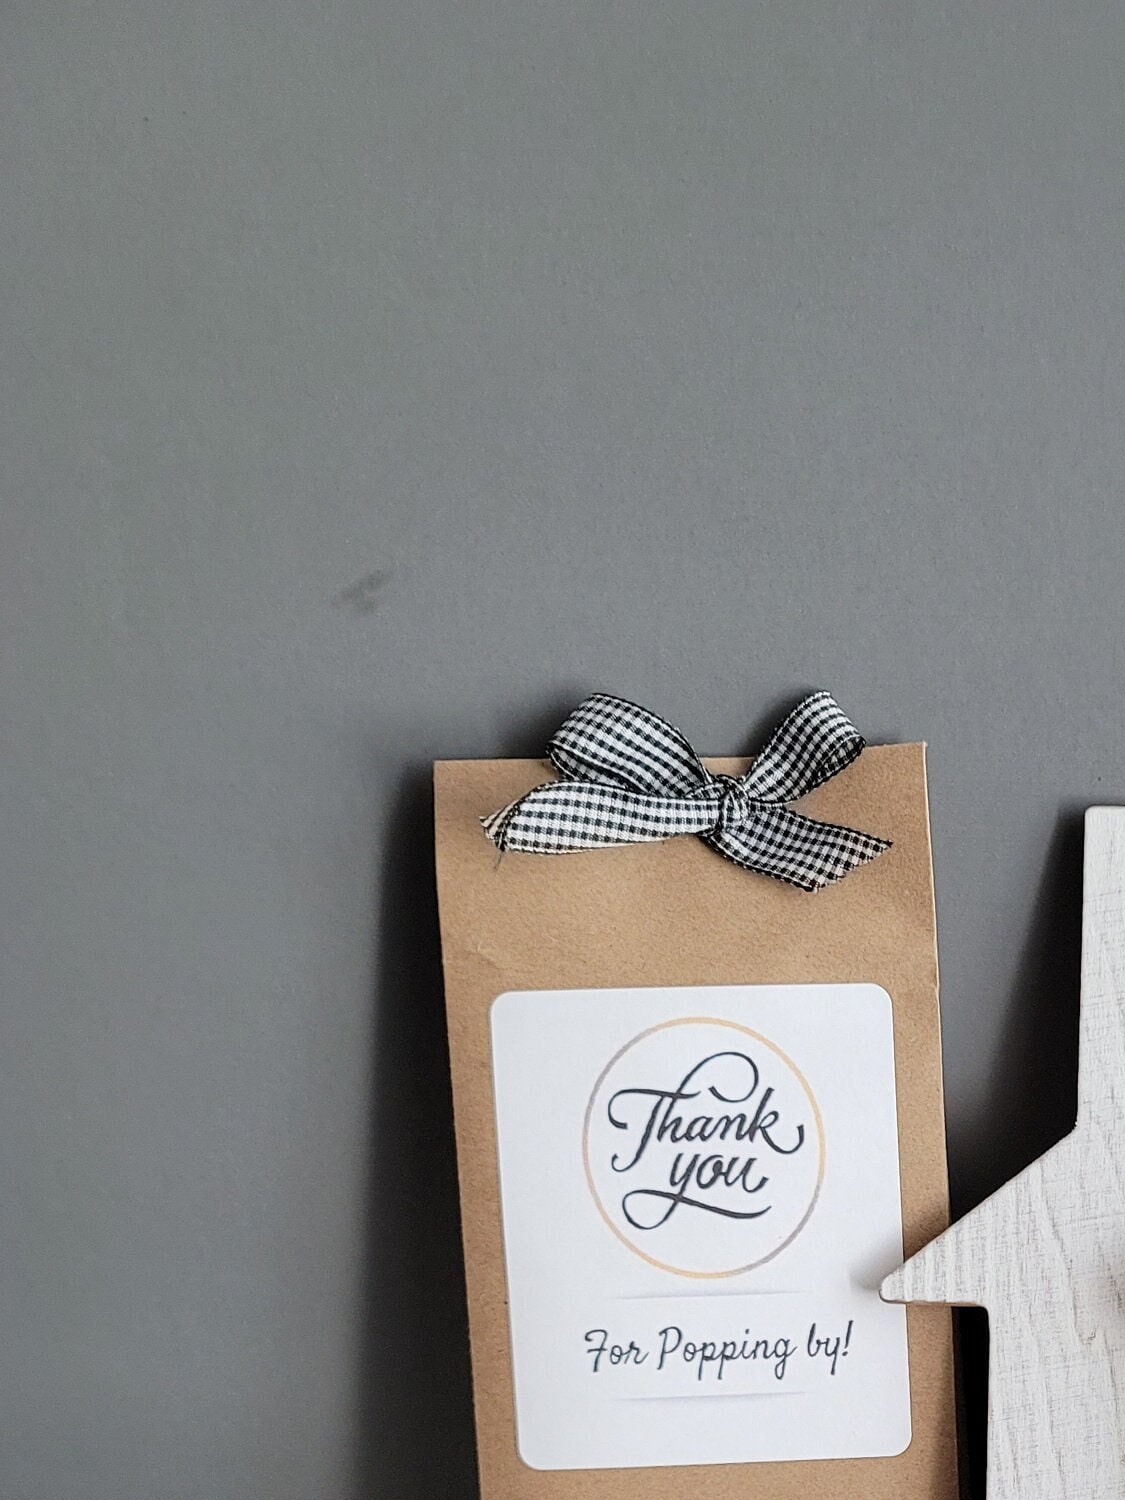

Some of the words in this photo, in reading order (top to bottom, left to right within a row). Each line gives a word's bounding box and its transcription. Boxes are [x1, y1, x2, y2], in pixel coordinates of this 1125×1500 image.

[607, 1051, 806, 1173] Thank
[621, 1152, 773, 1230] you
[584, 1328, 650, 1373] For
[657, 1325, 798, 1381] Popping
[806, 1320, 855, 1375] by!
